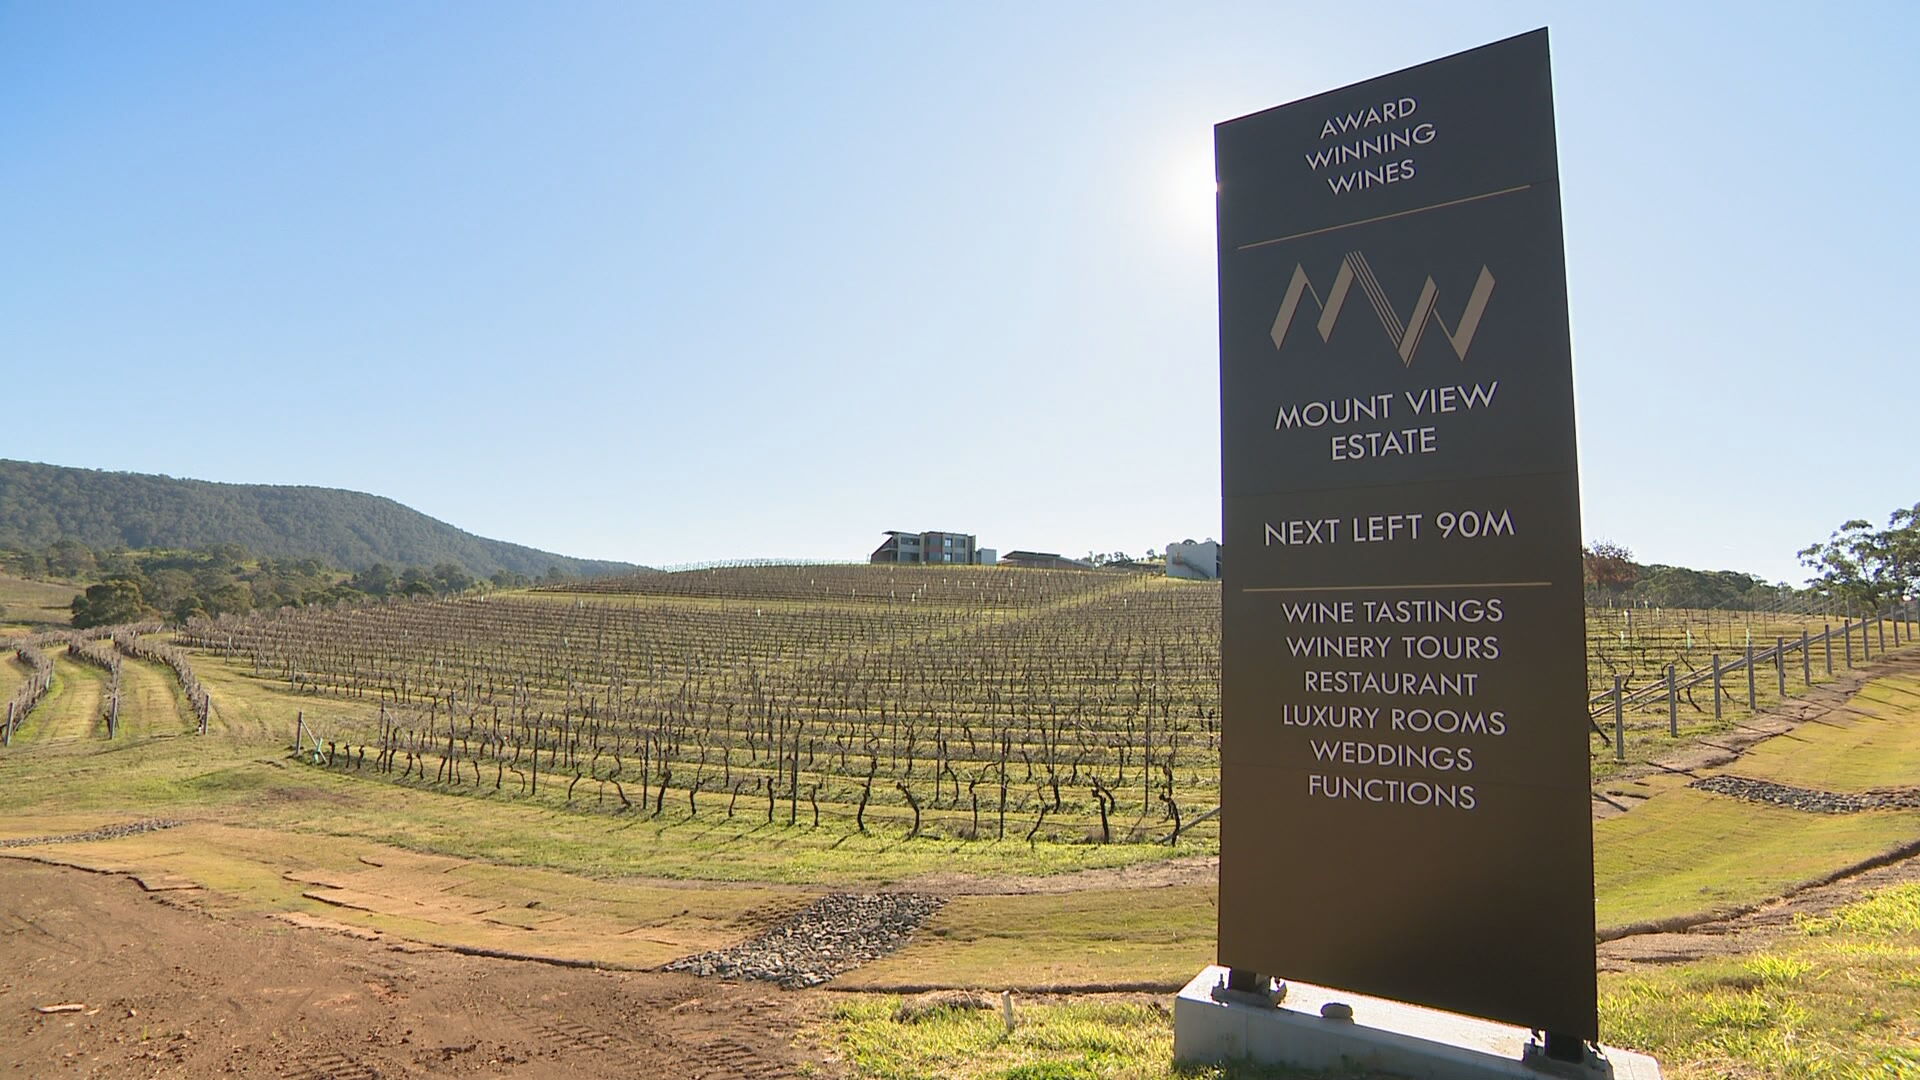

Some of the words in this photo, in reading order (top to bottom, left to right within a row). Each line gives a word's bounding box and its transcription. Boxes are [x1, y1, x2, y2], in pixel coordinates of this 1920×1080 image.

[1320, 97, 1417, 139] AWARD
[1305, 123, 1437, 171] WINNING
[1327, 159, 1416, 195] WINES
[1275, 393, 1394, 430] MOUNT
[1404, 380, 1499, 415] VIEW
[1331, 427, 1437, 461] ESTATE
[1264, 518, 1341, 546] NEXT
[1353, 513, 1423, 543] LEFT
[1436, 508, 1516, 539] 90M
[1281, 601, 1354, 624] WINE
[1362, 598, 1504, 624] TASTINGS
[1286, 636, 1392, 659] WINERY
[1401, 635, 1499, 660] TOURS
[1304, 670, 1478, 697] RESTAURANT
[1283, 703, 1380, 730] LUXURY
[1391, 708, 1507, 736] ROOMS
[1310, 739, 1474, 772] WEDDINGS
[1309, 774, 1477, 810] FUNCTIONS
